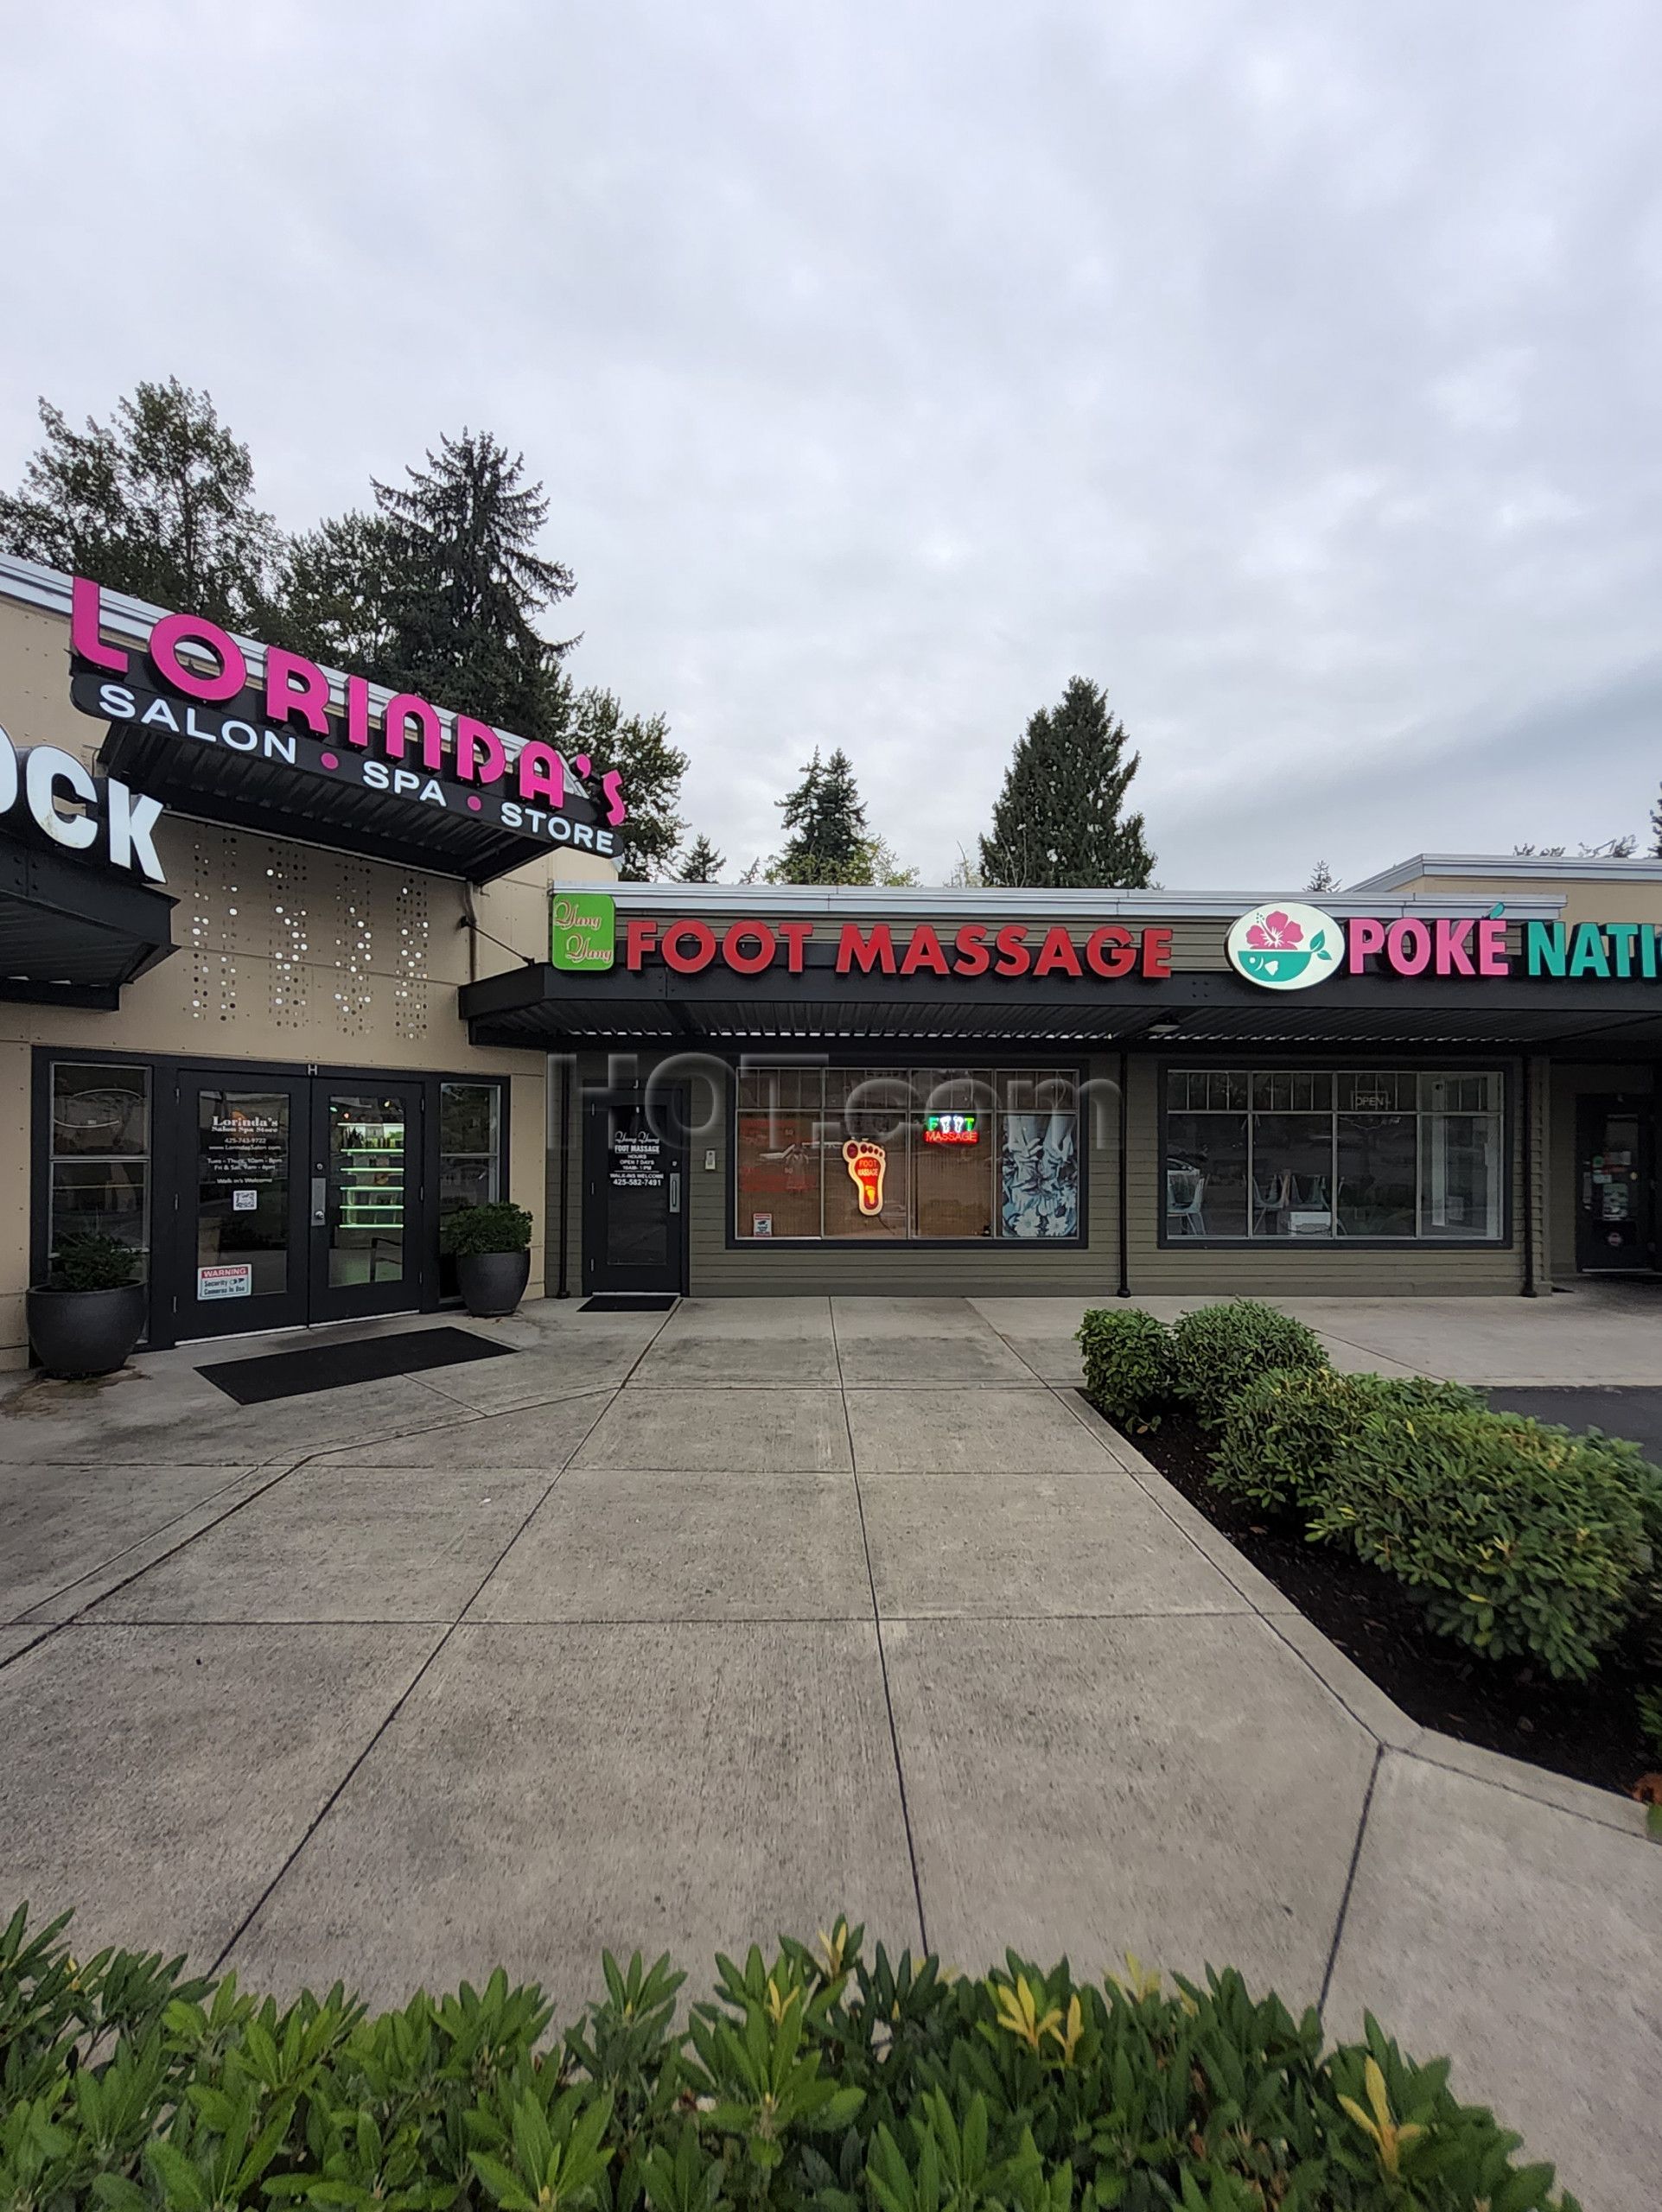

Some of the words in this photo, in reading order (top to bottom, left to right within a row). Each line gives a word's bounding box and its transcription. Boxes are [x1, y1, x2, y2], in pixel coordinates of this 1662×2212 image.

[72, 575, 626, 827] LORINDA'S
[99, 683, 296, 764] SALON
[362, 760, 448, 808] SPA
[500, 801, 614, 855] STORE
[0, 723, 167, 885] CK
[1348, 902, 1510, 976] POKÉ
[1527, 920, 1662, 979] NATI
[626, 918, 813, 974] FOOT
[835, 924, 1174, 979] MASSAGE
[308, 1064, 318, 1076] H
[1355, 1096, 1384, 1106] OPEN
[213, 1116, 278, 1127] Lorinda's
[925, 1131, 977, 1142] MASSAGE
[630, 1145, 659, 1154] MASSAGE
[203, 1268, 246, 1277] WARNING
